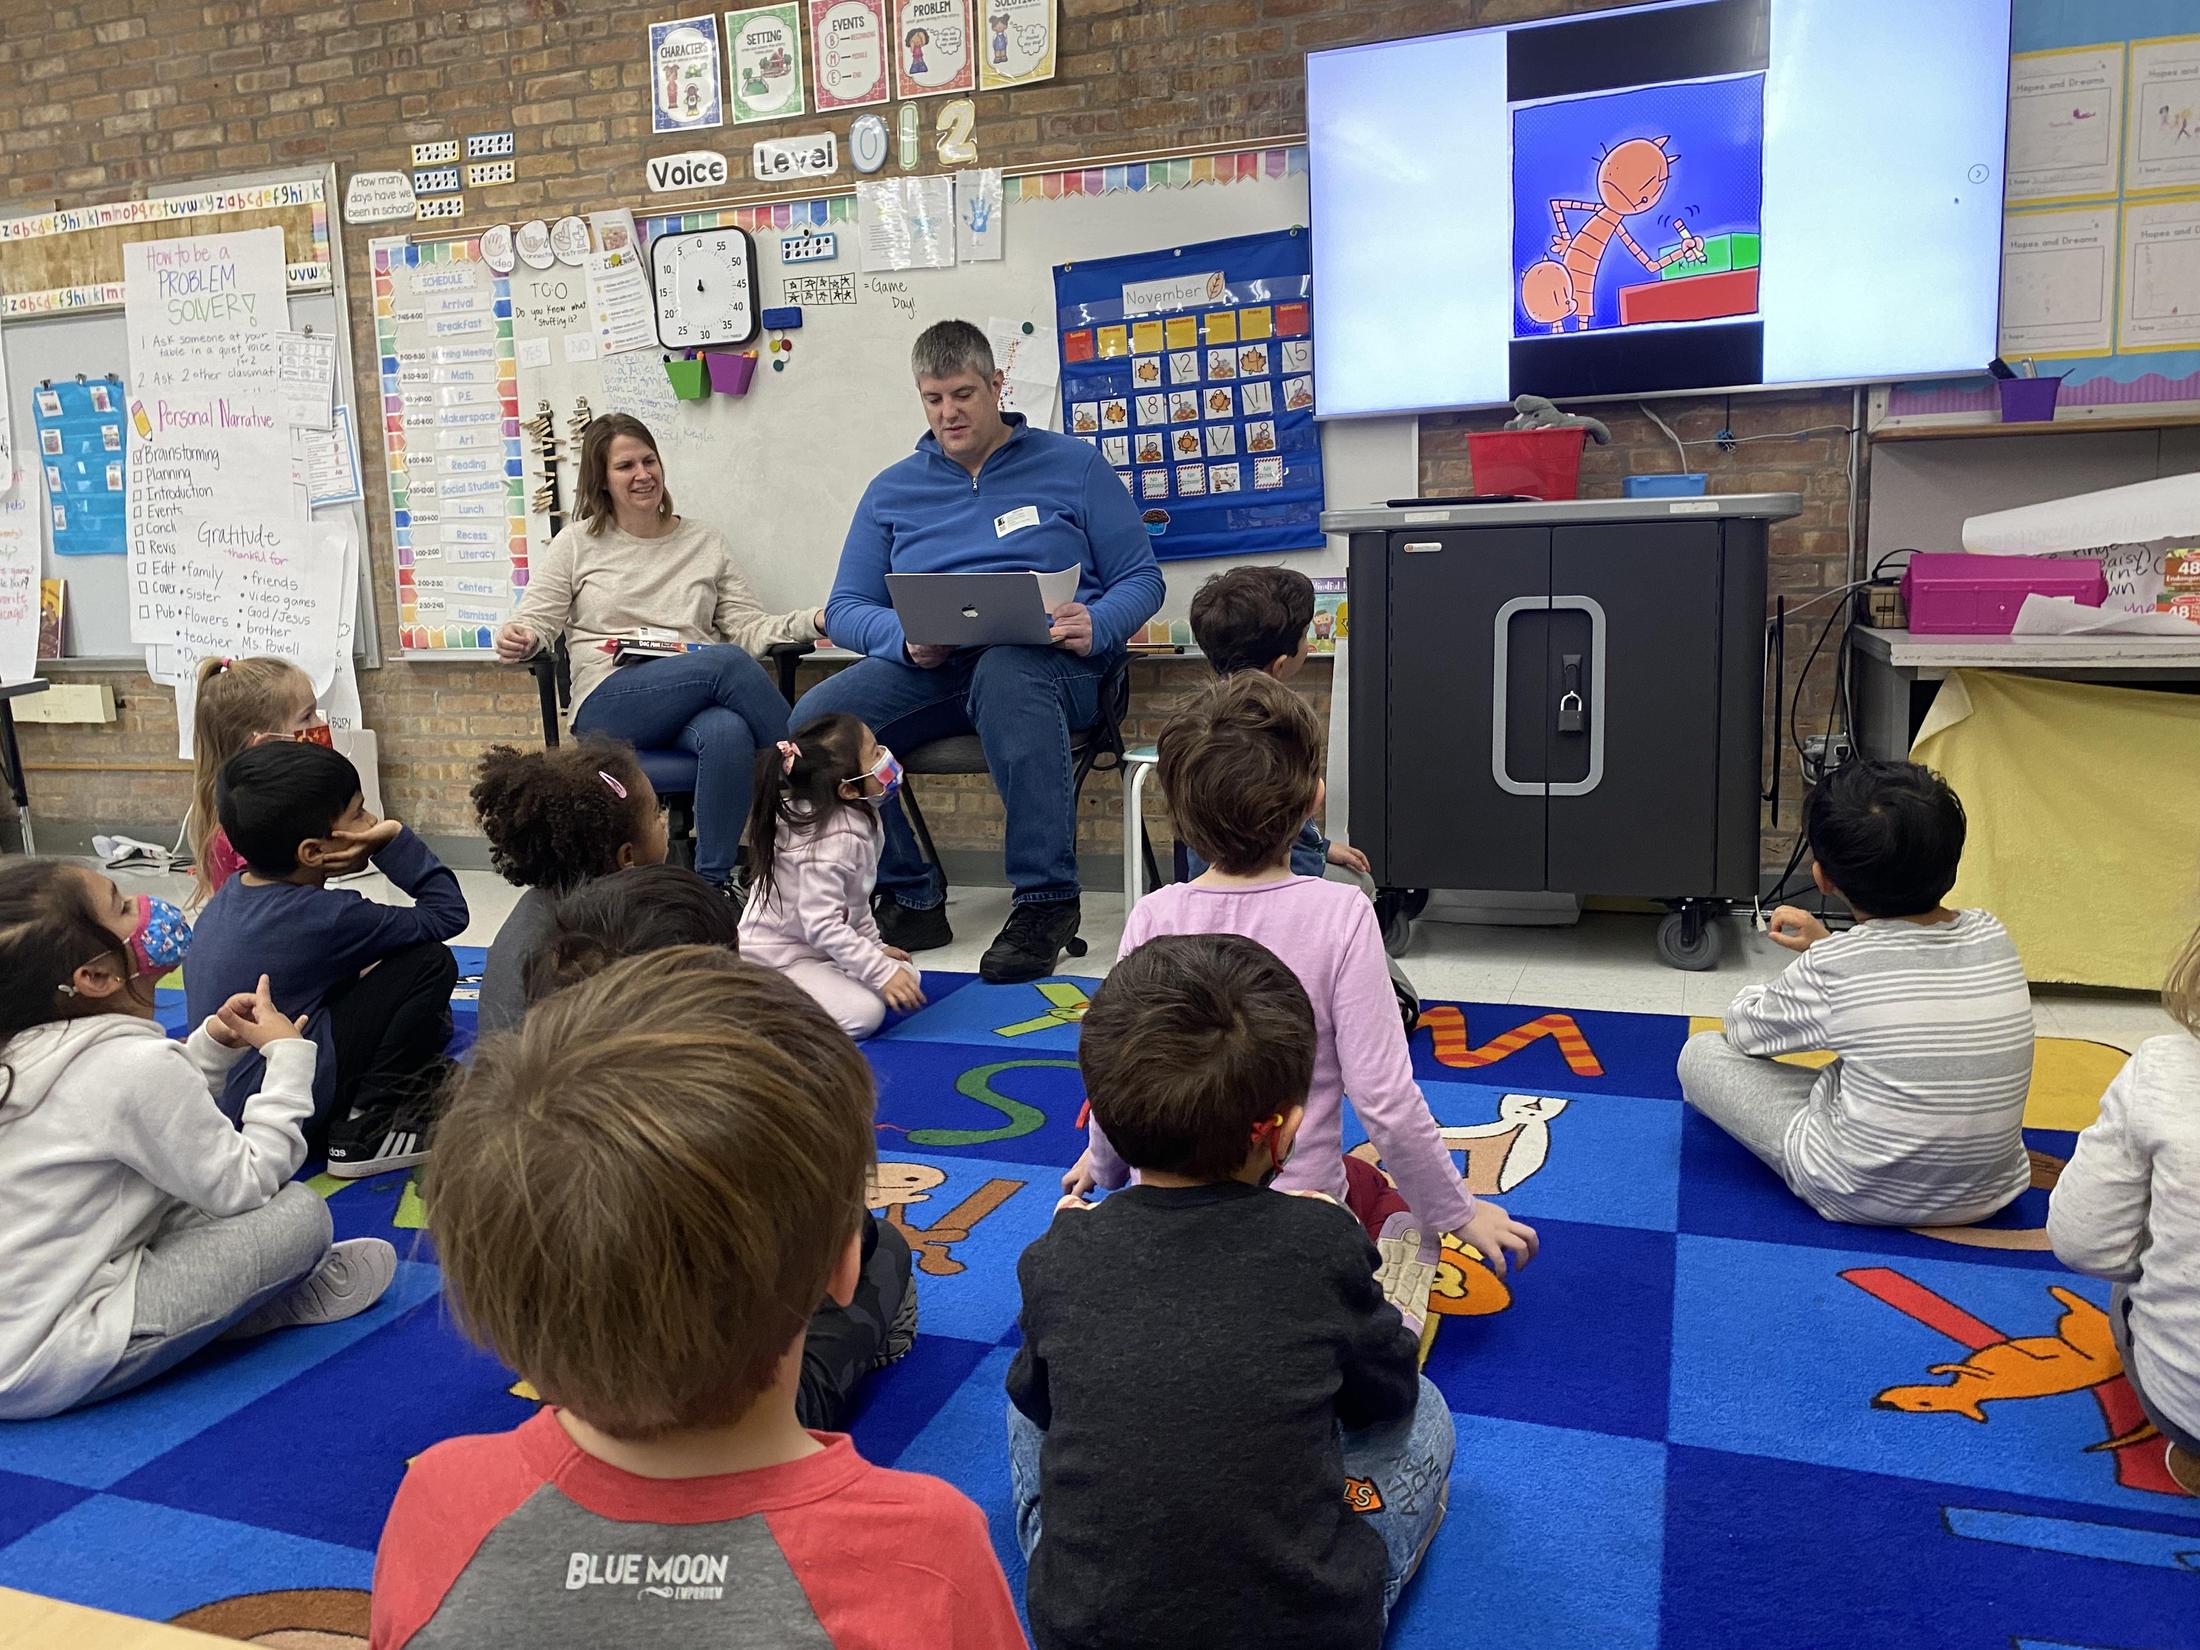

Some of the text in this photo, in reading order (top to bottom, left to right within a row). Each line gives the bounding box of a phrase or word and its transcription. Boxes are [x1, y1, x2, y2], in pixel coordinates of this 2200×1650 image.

[913, 1, 951, 17] PROBLEM
[832, 16, 865, 31] EVENTS
[746, 30, 782, 46] SETTING
[660, 41, 709, 58] CHARACTERS
[651, 140, 835, 188] Voice Level
[356, 176, 404, 188] How many
[350, 190, 412, 204] days have we
[373, 205, 380, 215] in
[382, 202, 415, 215] school?
[696, 239, 702, 248] 0
[716, 241, 726, 251] 55
[147, 244, 230, 271] How to be a
[677, 247, 683, 256] 5
[731, 256, 741, 266] 50
[663, 265, 672, 274] 10
[159, 264, 236, 299] PROBLEM
[422, 274, 463, 288] SCHEDULE
[736, 279, 747, 288] 45
[872, 277, 908, 293] Game
[659, 288, 668, 297] 15
[1126, 284, 1202, 305] November
[168, 293, 257, 327] SOLVER!
[441, 298, 474, 310] Arrival
[733, 302, 744, 311] 40
[892, 296, 917, 319] Day!
[515, 307, 525, 318] Do
[531, 307, 543, 320] you
[665, 309, 675, 318] 20
[436, 320, 482, 332] Breakfast
[678, 326, 688, 335] 25
[722, 320, 732, 330] 35
[153, 334, 174, 347] Ask
[180, 334, 225, 344] someone
[230, 332, 241, 341] at
[245, 332, 268, 346] your
[700, 331, 710, 340] 30
[160, 346, 185, 357] table
[192, 346, 201, 355] in
[219, 344, 242, 359] quiet
[247, 342, 271, 352] voice
[1209, 351, 1220, 369] 3
[1295, 342, 1308, 361] 5
[154, 372, 174, 386] Ask
[193, 369, 221, 380] other
[450, 370, 474, 380] Math
[158, 398, 274, 432] Personal Narrative
[1074, 403, 1085, 421] 6
[1148, 396, 1158, 414] 8
[440, 413, 496, 424] Makerspace
[459, 435, 474, 445] Art
[145, 443, 220, 471] Brainstorming
[451, 460, 486, 470] Reading
[146, 467, 192, 486] Planning
[146, 485, 213, 500] Introduction
[441, 480, 500, 495] Social Studies
[148, 503, 183, 519] Events
[458, 504, 485, 514] Lunch
[198, 521, 280, 548] Gratitude
[456, 530, 488, 541] Recess
[269, 552, 288, 566] for
[458, 549, 496, 560] Literacy
[153, 561, 176, 577] Edit
[187, 561, 224, 590] family
[252, 571, 298, 591] friends
[458, 581, 493, 593] Centers
[186, 585, 221, 602] Sister
[249, 591, 316, 611] Video games
[184, 605, 229, 627] flowers
[458, 609, 497, 621] Dismissal
[247, 622, 292, 637] brother
[185, 628, 232, 648] teacher
[265, 639, 300, 655] Powell
[565, 1552, 729, 1590] BLUE MOON
